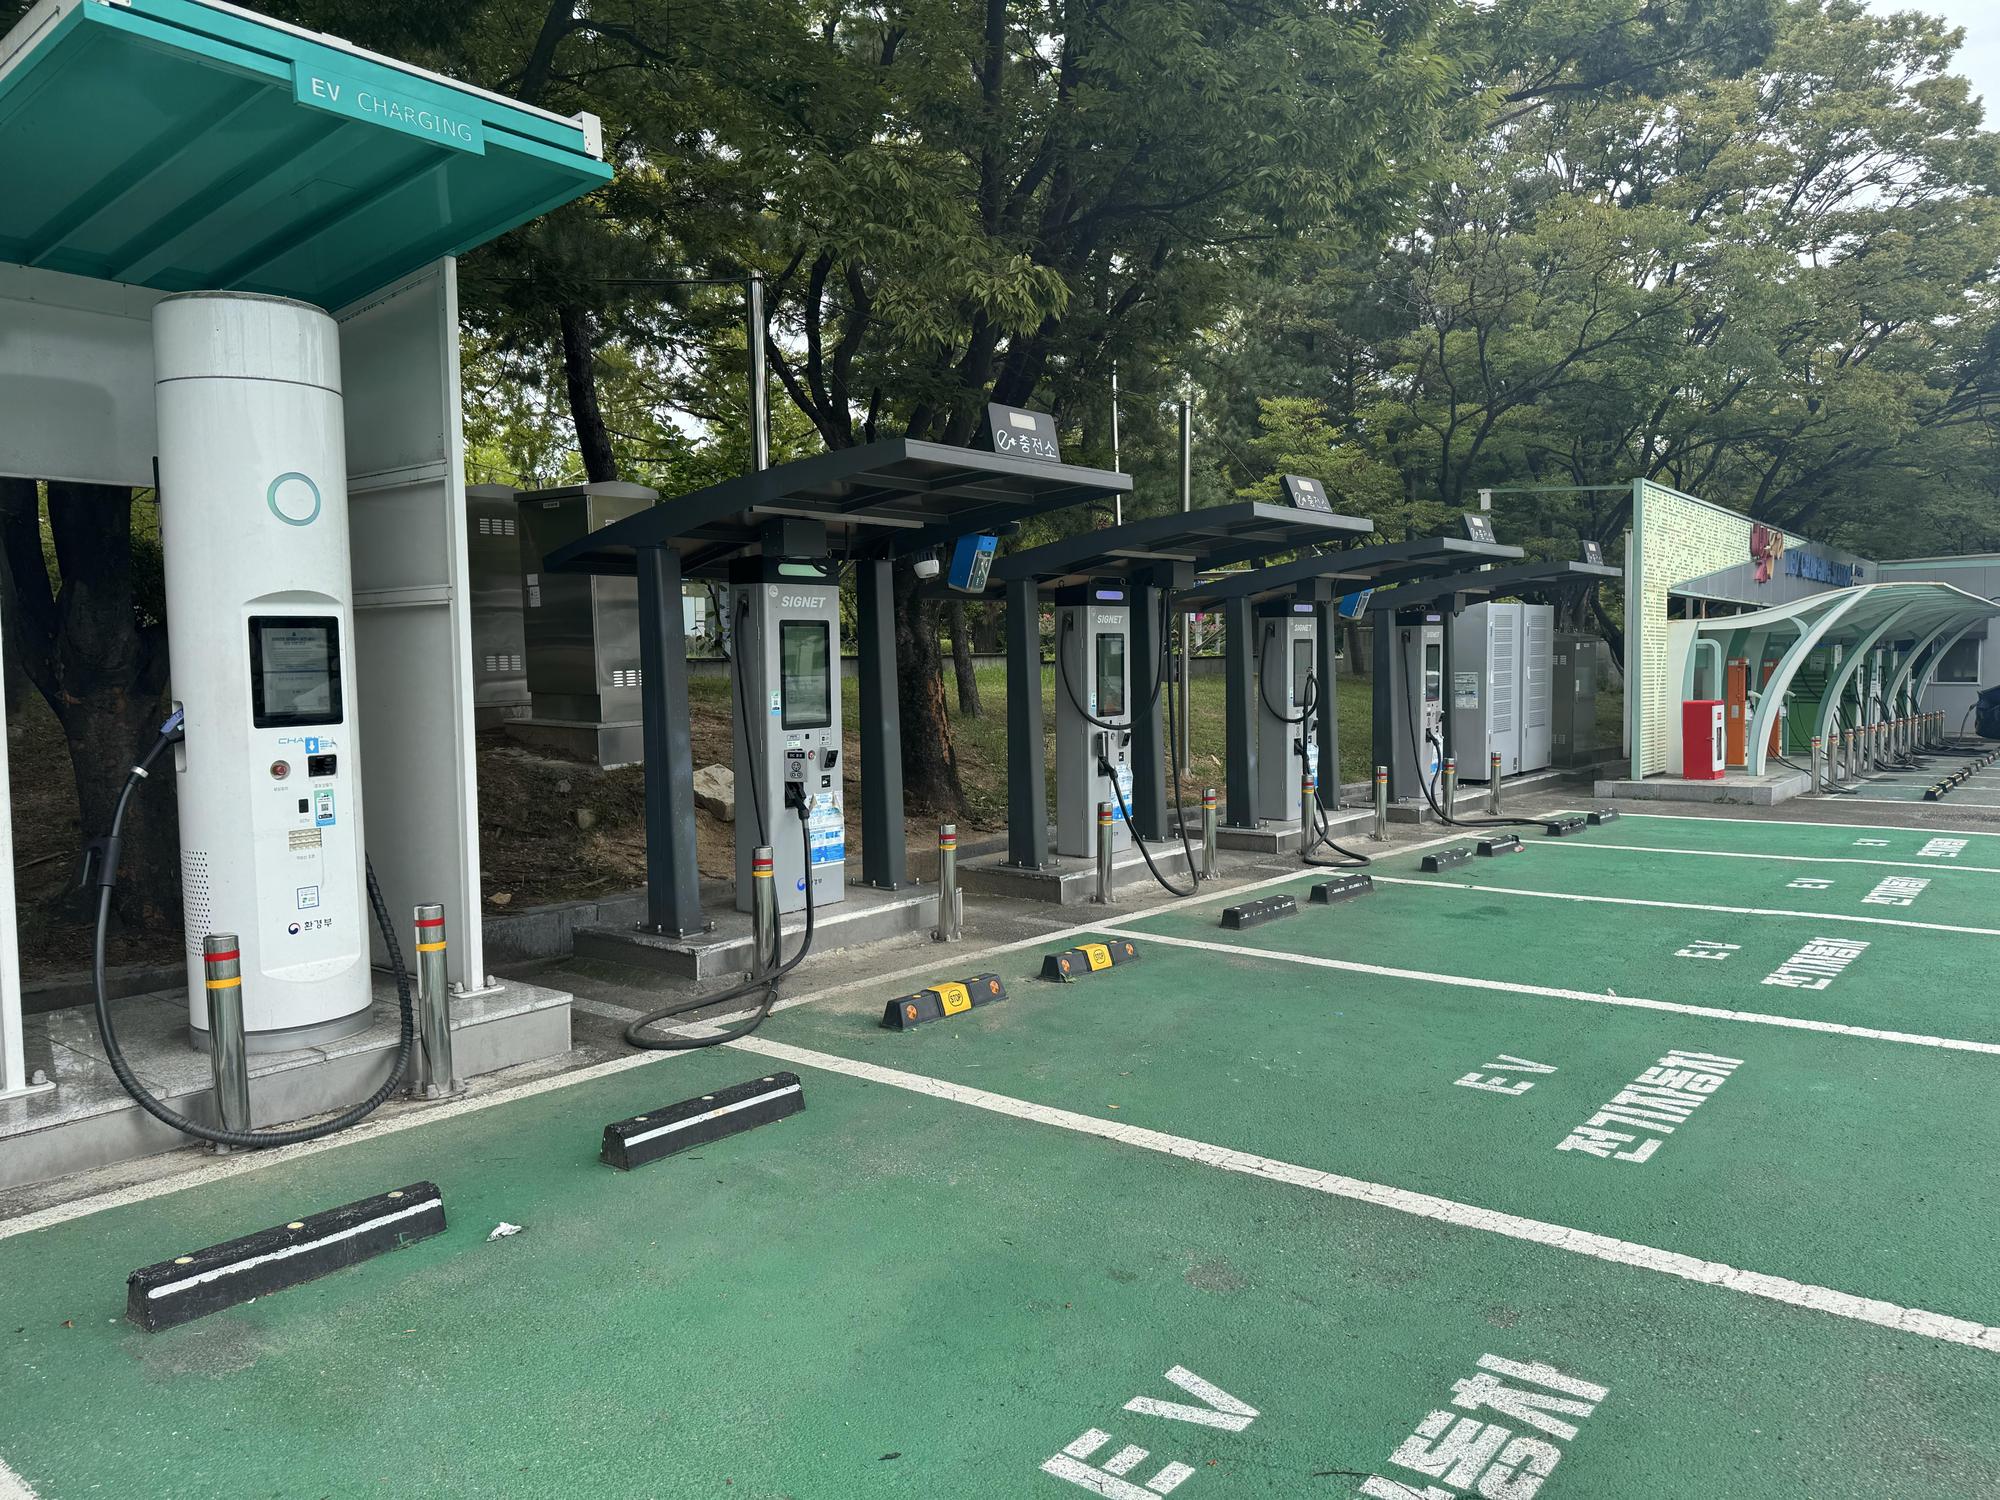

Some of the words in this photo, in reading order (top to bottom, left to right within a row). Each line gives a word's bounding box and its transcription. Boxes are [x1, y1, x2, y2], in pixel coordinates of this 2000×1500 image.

[311, 77, 340, 102] EV
[357, 92, 472, 142] CHARGING
[1019, 434, 1057, 458] 충전소
[781, 595, 827, 609] SIGNET
[1097, 614, 1123, 624] SIGNET
[304, 917, 333, 931] 환경부
[1674, 939, 1742, 961] EV
[1760, 937, 1872, 990] 전기자동차
[950, 993, 962, 1004] STOP
[1453, 1053, 1559, 1096] EV
[1554, 1049, 1745, 1163] 전기자동차
[1038, 1364, 1261, 1500] EV
